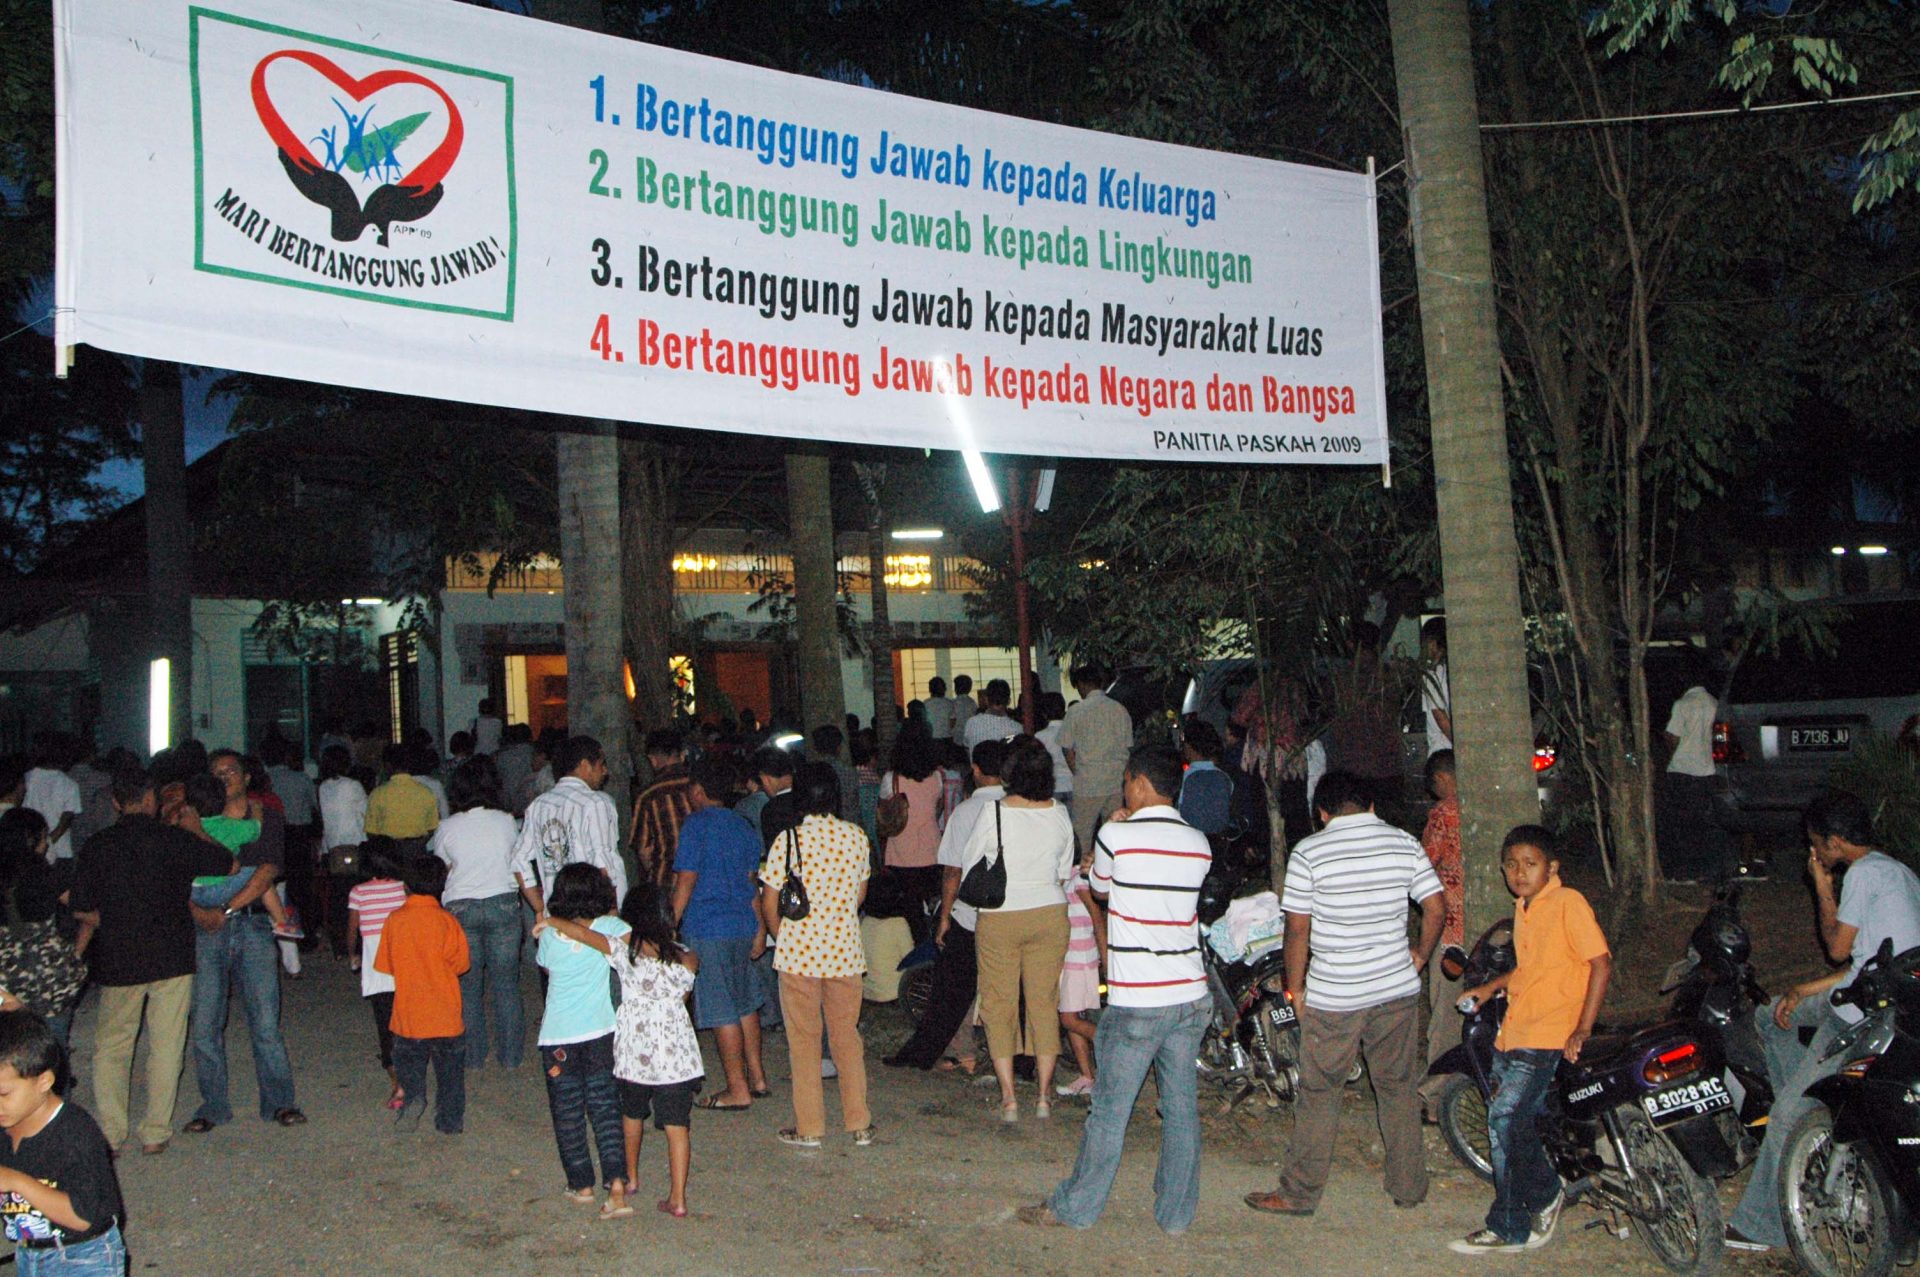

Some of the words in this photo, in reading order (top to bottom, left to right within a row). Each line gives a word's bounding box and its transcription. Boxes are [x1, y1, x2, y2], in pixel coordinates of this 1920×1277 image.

[588, 74, 621, 126] 1.
[635, 82, 860, 180] Bertanggung
[869, 129, 972, 189] Jawab
[982, 147, 1088, 207] kepada
[1098, 165, 1217, 228] Keluarga
[213, 187, 271, 245] MARI
[267, 224, 425, 288] BERTANGGUNG
[588, 148, 622, 200] 2.
[636, 156, 859, 248] Bertanggung
[870, 198, 972, 254] Jawab
[982, 213, 1089, 271] kepada
[1098, 229, 1253, 290] Lingkungan
[590, 238, 624, 289] 3.
[638, 244, 861, 329] Bertanggung
[871, 277, 973, 331] Jawab
[984, 289, 1091, 346] kepada
[1101, 302, 1260, 357] Masyarakat
[1266, 315, 1324, 358] Luas
[589, 313, 624, 363] 4.
[638, 318, 861, 397] Bertanggung
[983, 355, 1091, 410] kepada
[1099, 365, 1197, 418] Negara
[1205, 372, 1254, 413] dan
[1262, 375, 1356, 424] Bangsa
[1153, 430, 1233, 452] PANITIA
[1237, 434, 1316, 452] PASKAH
[1320, 436, 1362, 453] 2009
[1791, 730, 1800, 744] B
[1803, 729, 1829, 744] 7136
[1568, 1082, 1604, 1103] SUZUKI
[1644, 1097, 1659, 1114] B
[1659, 1085, 1700, 1109] 3028
[1698, 1077, 1723, 1097] RC
